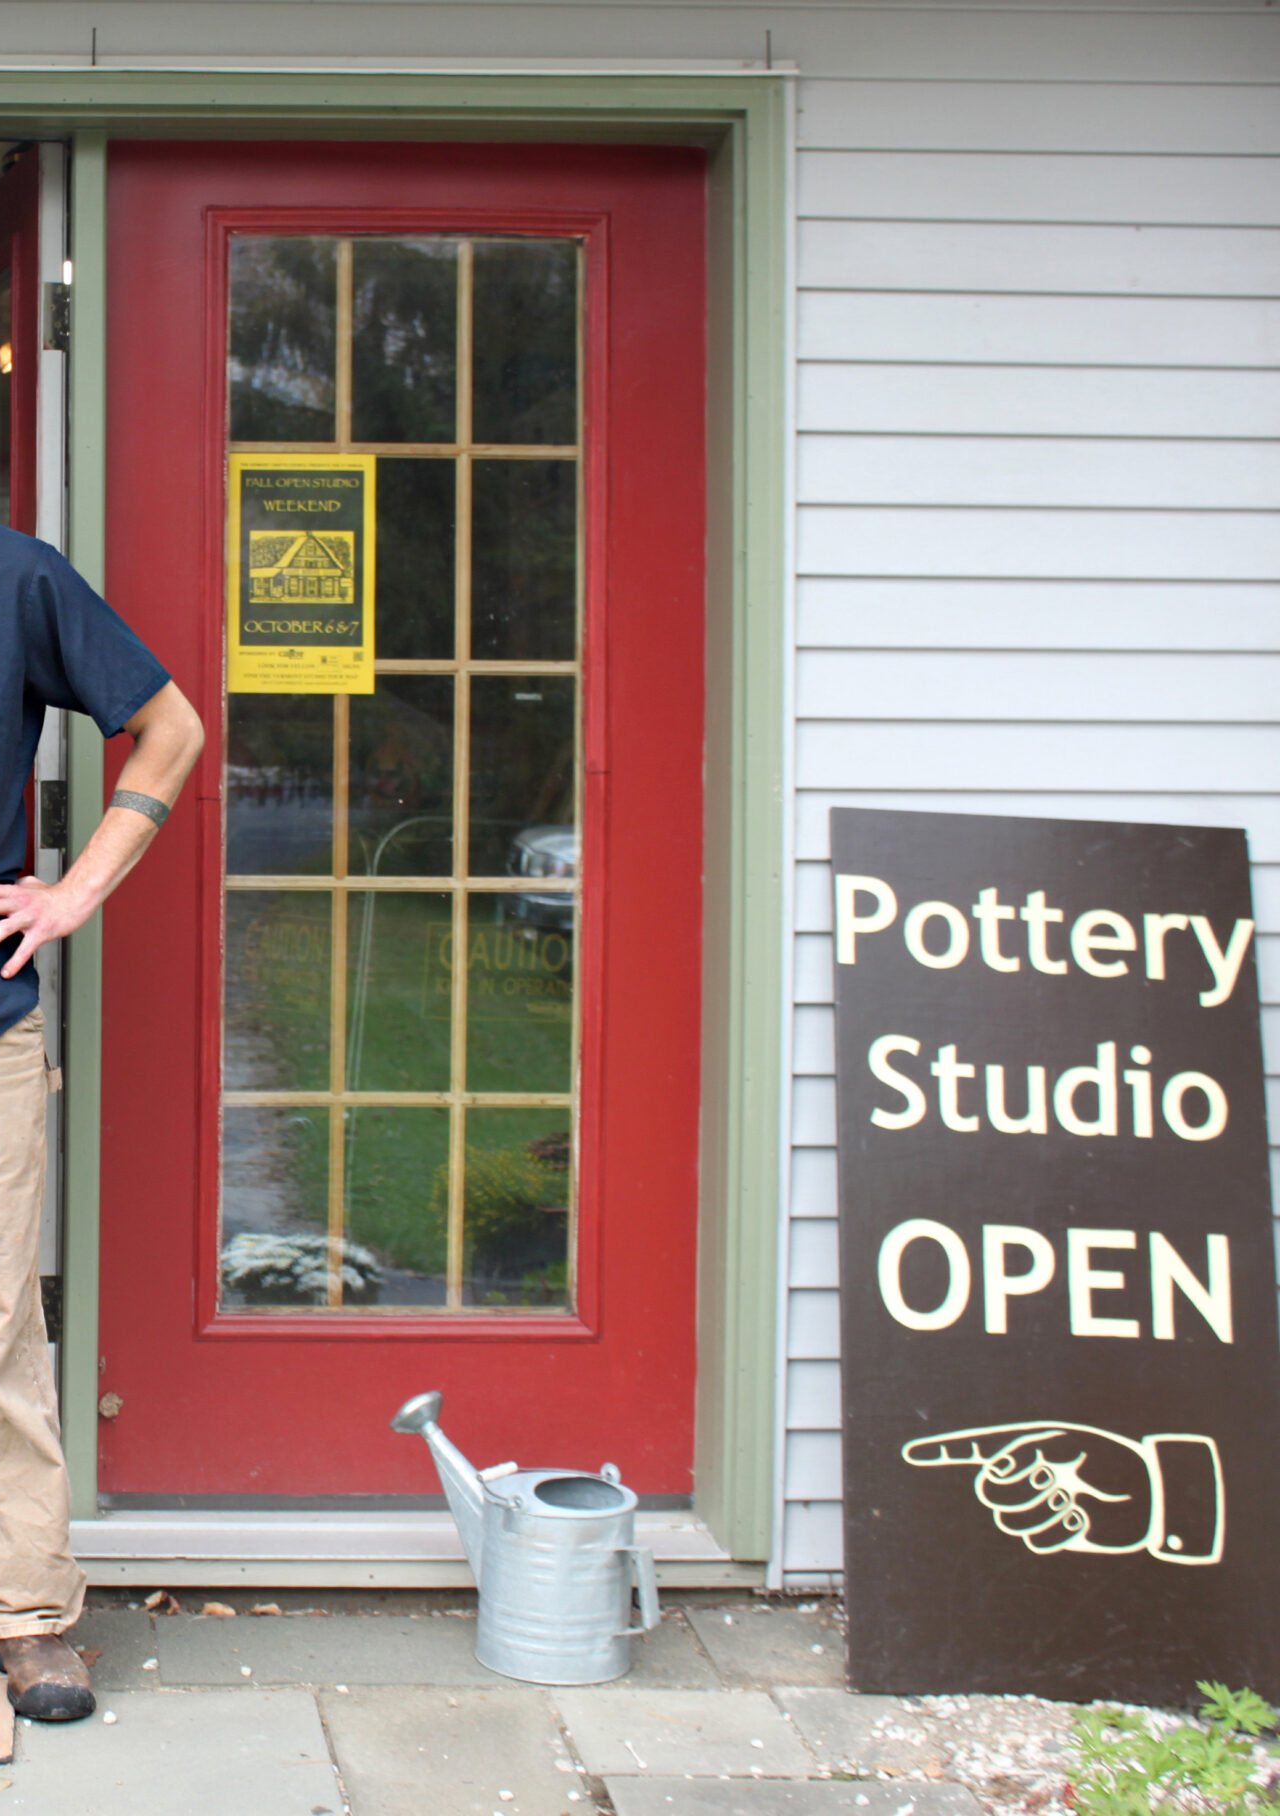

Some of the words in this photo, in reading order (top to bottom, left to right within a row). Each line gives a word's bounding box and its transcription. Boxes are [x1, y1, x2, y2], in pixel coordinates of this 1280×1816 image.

[245, 477, 273, 489] FALL
[275, 477, 311, 489] OPEN
[312, 477, 360, 489] STUDIO
[262, 499, 342, 513] WEEKEND
[243, 619, 324, 634] OCTOBER
[324, 618, 335, 634] 6
[349, 620, 360, 637] 7
[441, 929, 569, 972] CAUTIO
[834, 873, 1256, 1008] Pottery
[867, 1033, 1229, 1142] Studio
[877, 1218, 1234, 1345] OPEN
